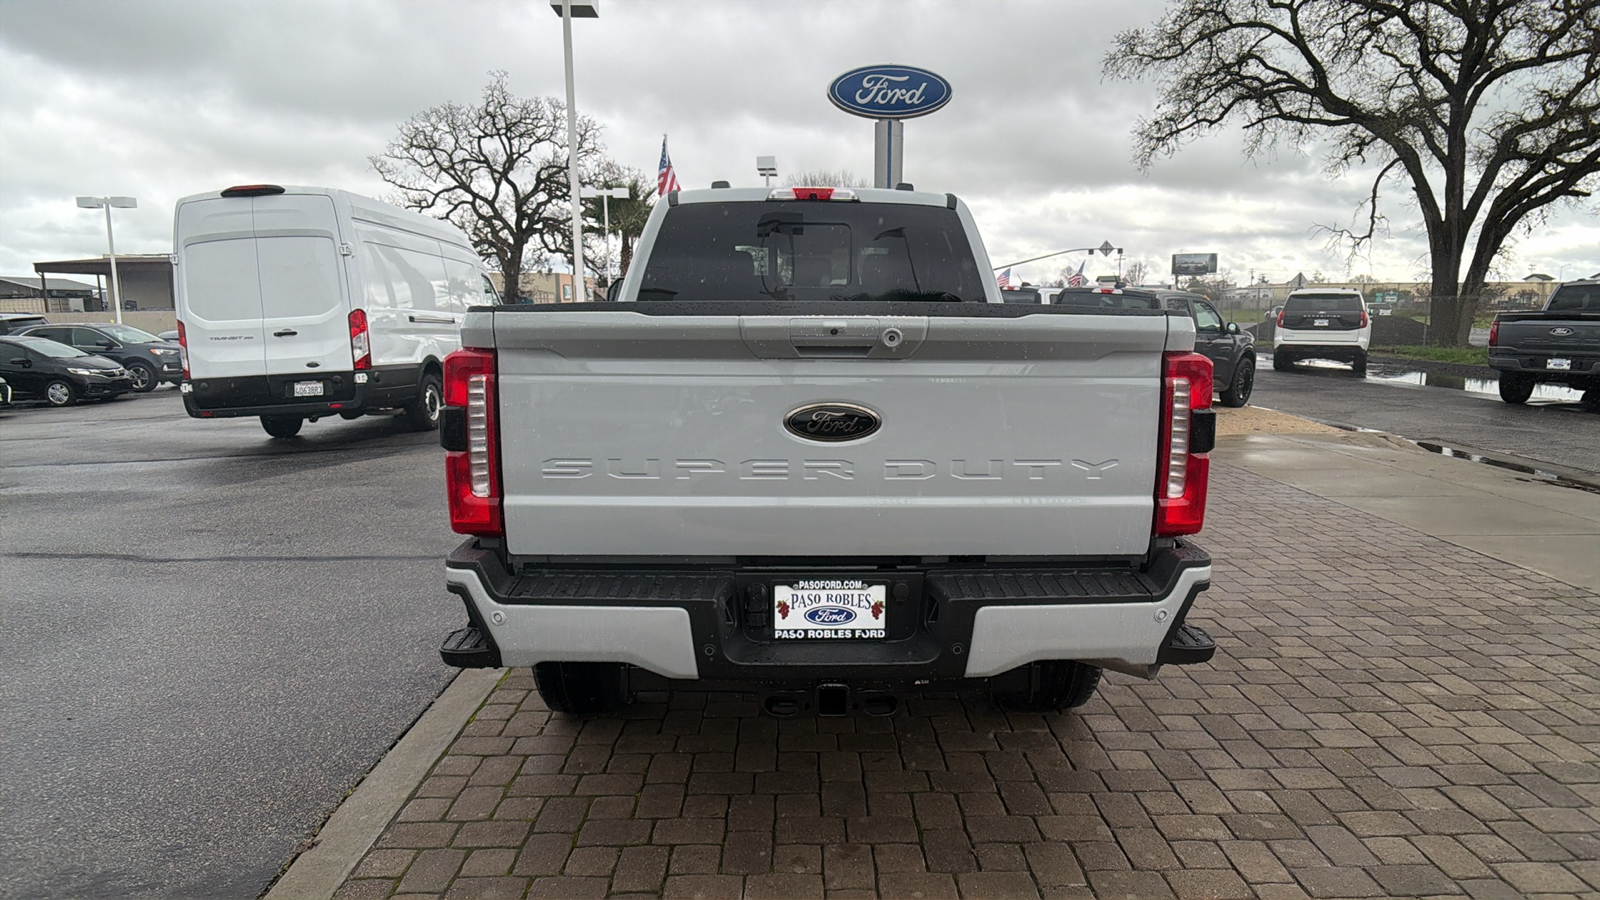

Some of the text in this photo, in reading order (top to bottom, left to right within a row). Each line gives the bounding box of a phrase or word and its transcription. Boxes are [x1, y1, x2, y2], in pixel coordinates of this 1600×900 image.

[855, 74, 927, 104] Ford
[806, 410, 859, 432] Ford
[542, 458, 1119, 480] SUPER DUTY
[799, 581, 862, 589] PASOFORD.COM
[791, 593, 872, 610] PASO ROBLES
[815, 609, 847, 621] Ford
[774, 630, 886, 638] PASO ROBLES FORD
